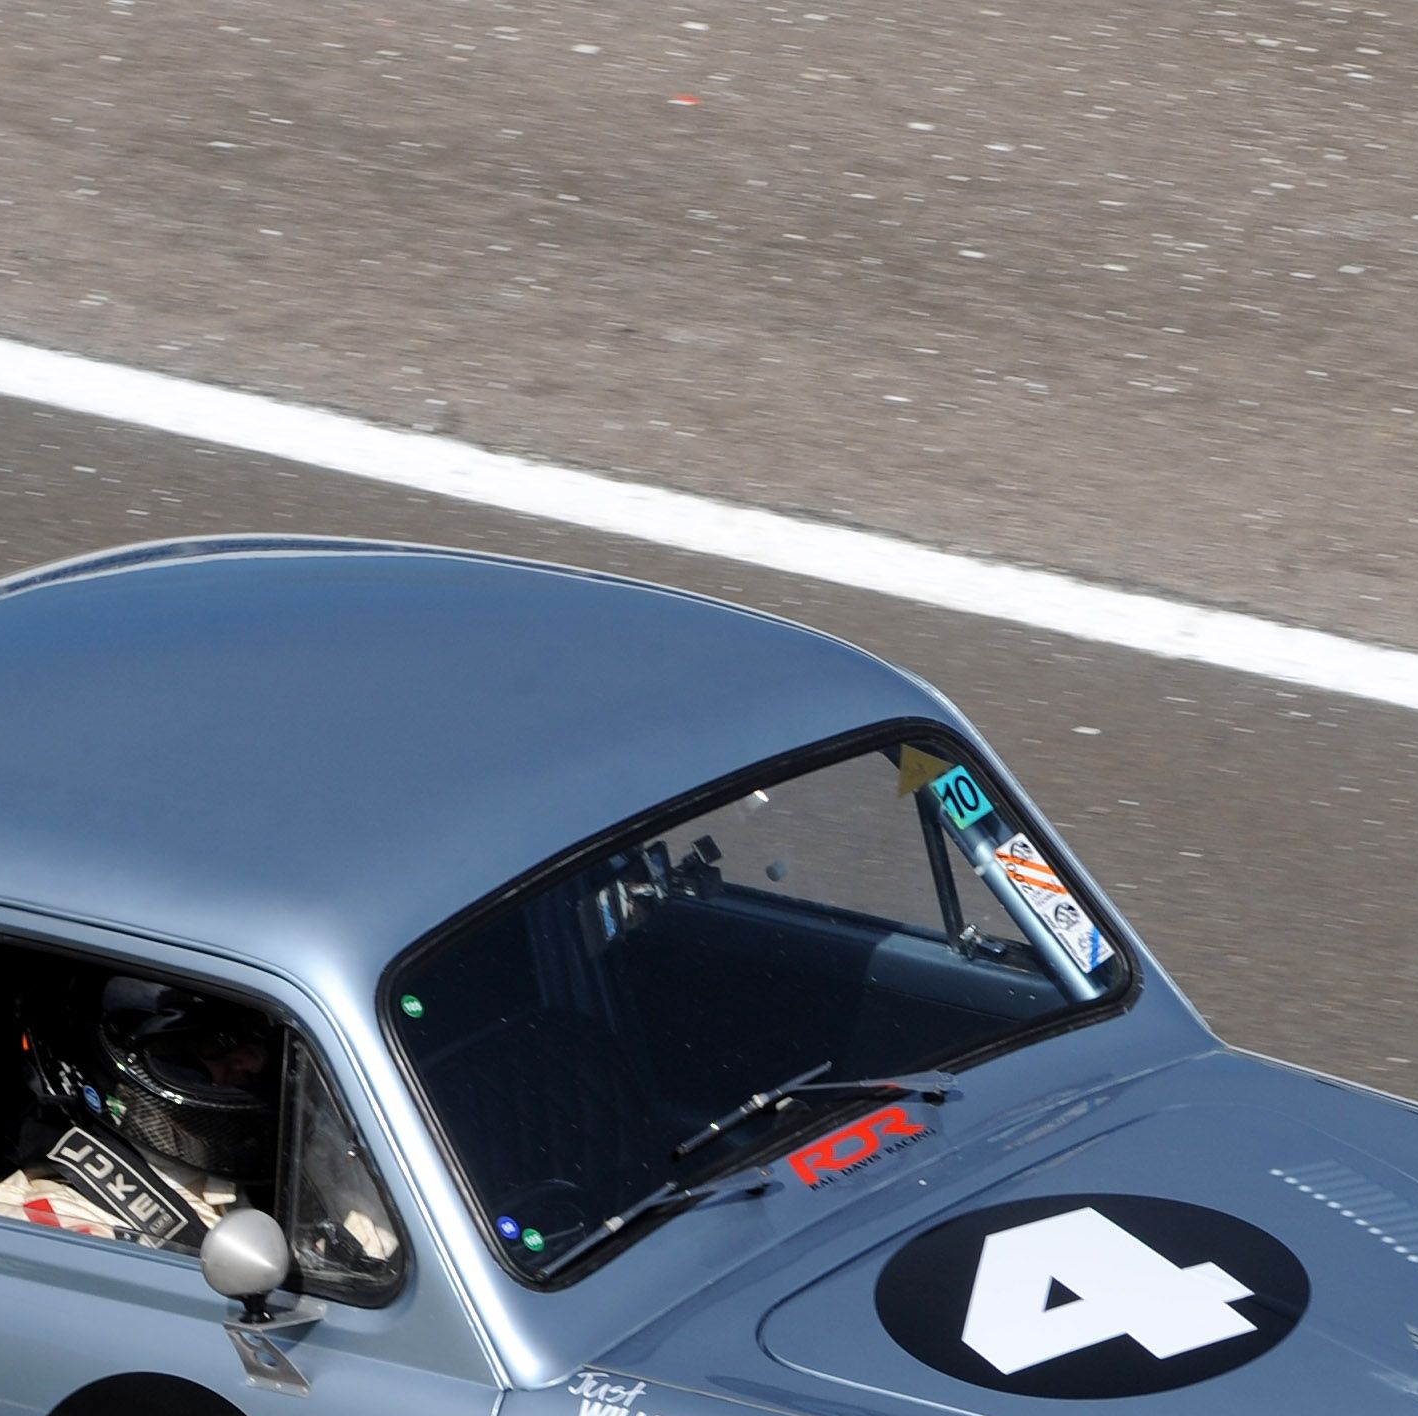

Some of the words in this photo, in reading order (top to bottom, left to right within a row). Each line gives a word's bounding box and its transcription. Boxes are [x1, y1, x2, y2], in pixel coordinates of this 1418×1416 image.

[942, 776, 979, 819] 10
[841, 1152, 882, 1177] DAVIS
[885, 1128, 936, 1155] RACING
[60, 1144, 162, 1222] LUKE
[962, 1207, 1258, 1375] 4
[568, 1373, 647, 1407] Just
